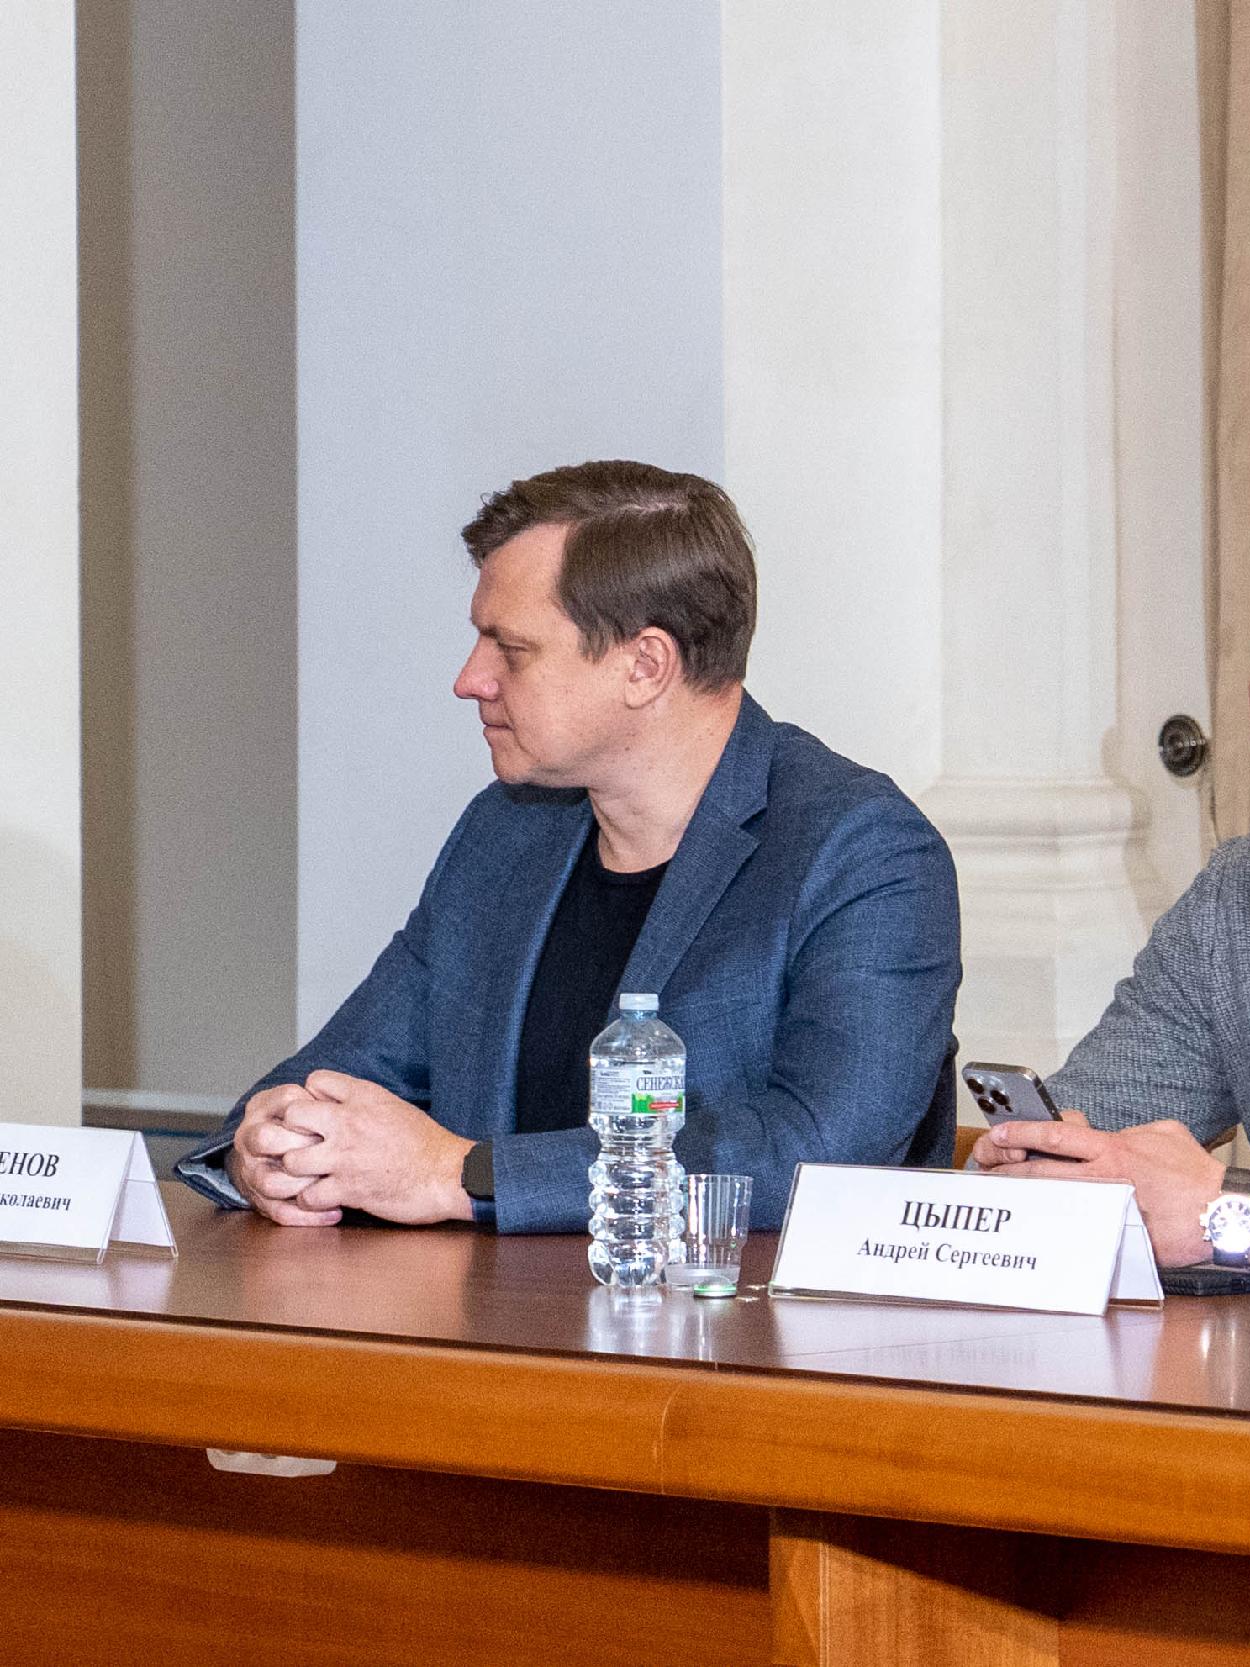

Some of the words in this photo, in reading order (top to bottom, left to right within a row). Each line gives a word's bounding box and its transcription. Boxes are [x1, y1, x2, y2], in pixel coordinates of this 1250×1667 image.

[900, 1200, 1012, 1234] ЦЫПЕР
[857, 1238, 929, 1265] Андрей
[935, 1242, 1038, 1271] Сергеевич
